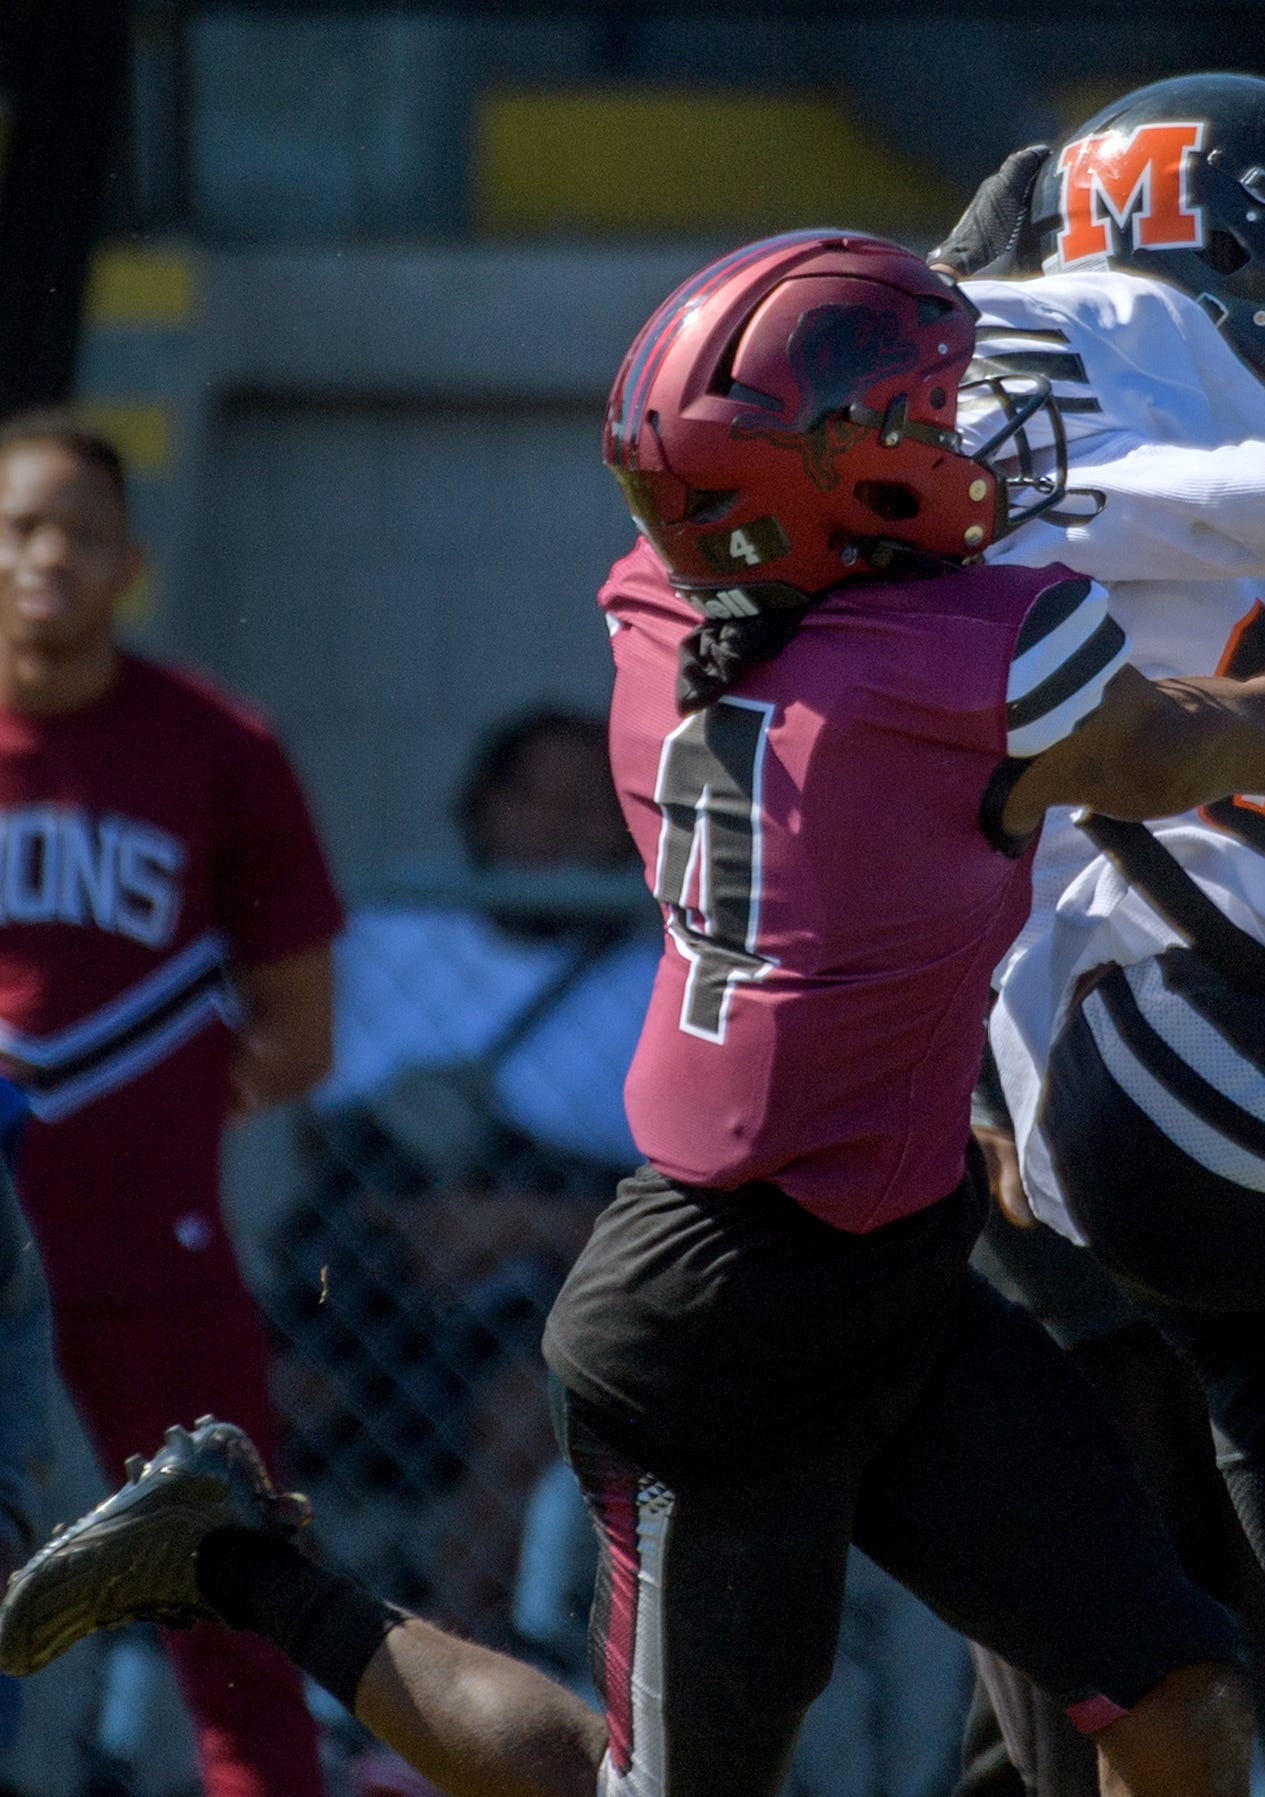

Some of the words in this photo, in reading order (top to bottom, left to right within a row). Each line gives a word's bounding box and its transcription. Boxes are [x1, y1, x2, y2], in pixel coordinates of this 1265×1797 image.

[1055, 122, 1205, 268] M
[730, 529, 761, 566] 4
[654, 696, 780, 1045] 4
